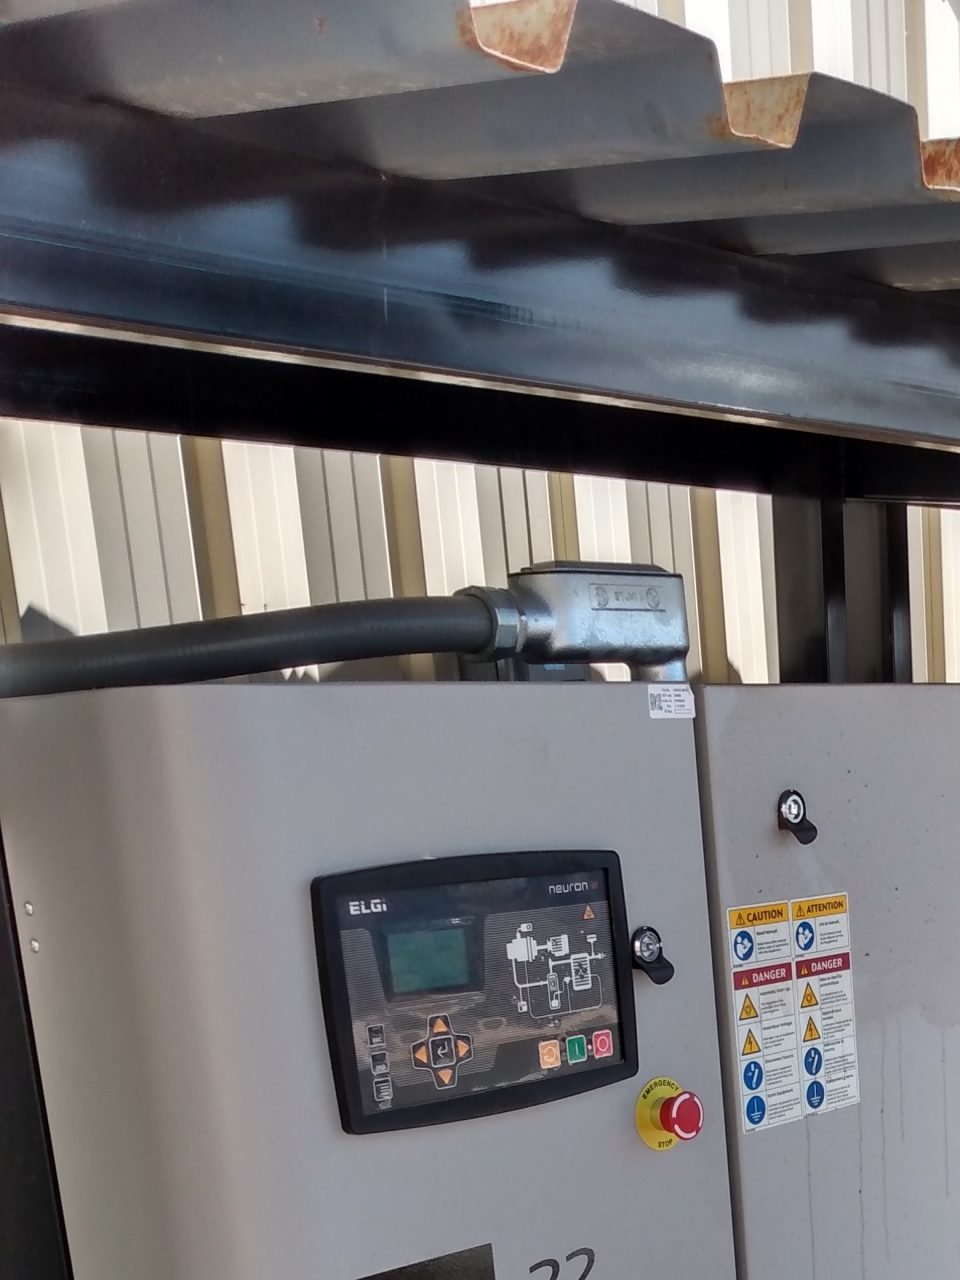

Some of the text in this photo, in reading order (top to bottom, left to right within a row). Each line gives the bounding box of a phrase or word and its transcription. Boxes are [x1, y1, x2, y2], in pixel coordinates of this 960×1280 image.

[548, 881, 589, 895] neuron
[806, 900, 844, 915] ATTENTION
[746, 908, 784, 923] CAUTION
[811, 958, 843, 973] DANGER
[752, 967, 787, 983] DANGER
[641, 1079, 680, 1100] EMERGENCY
[657, 1138, 673, 1149] STOP
